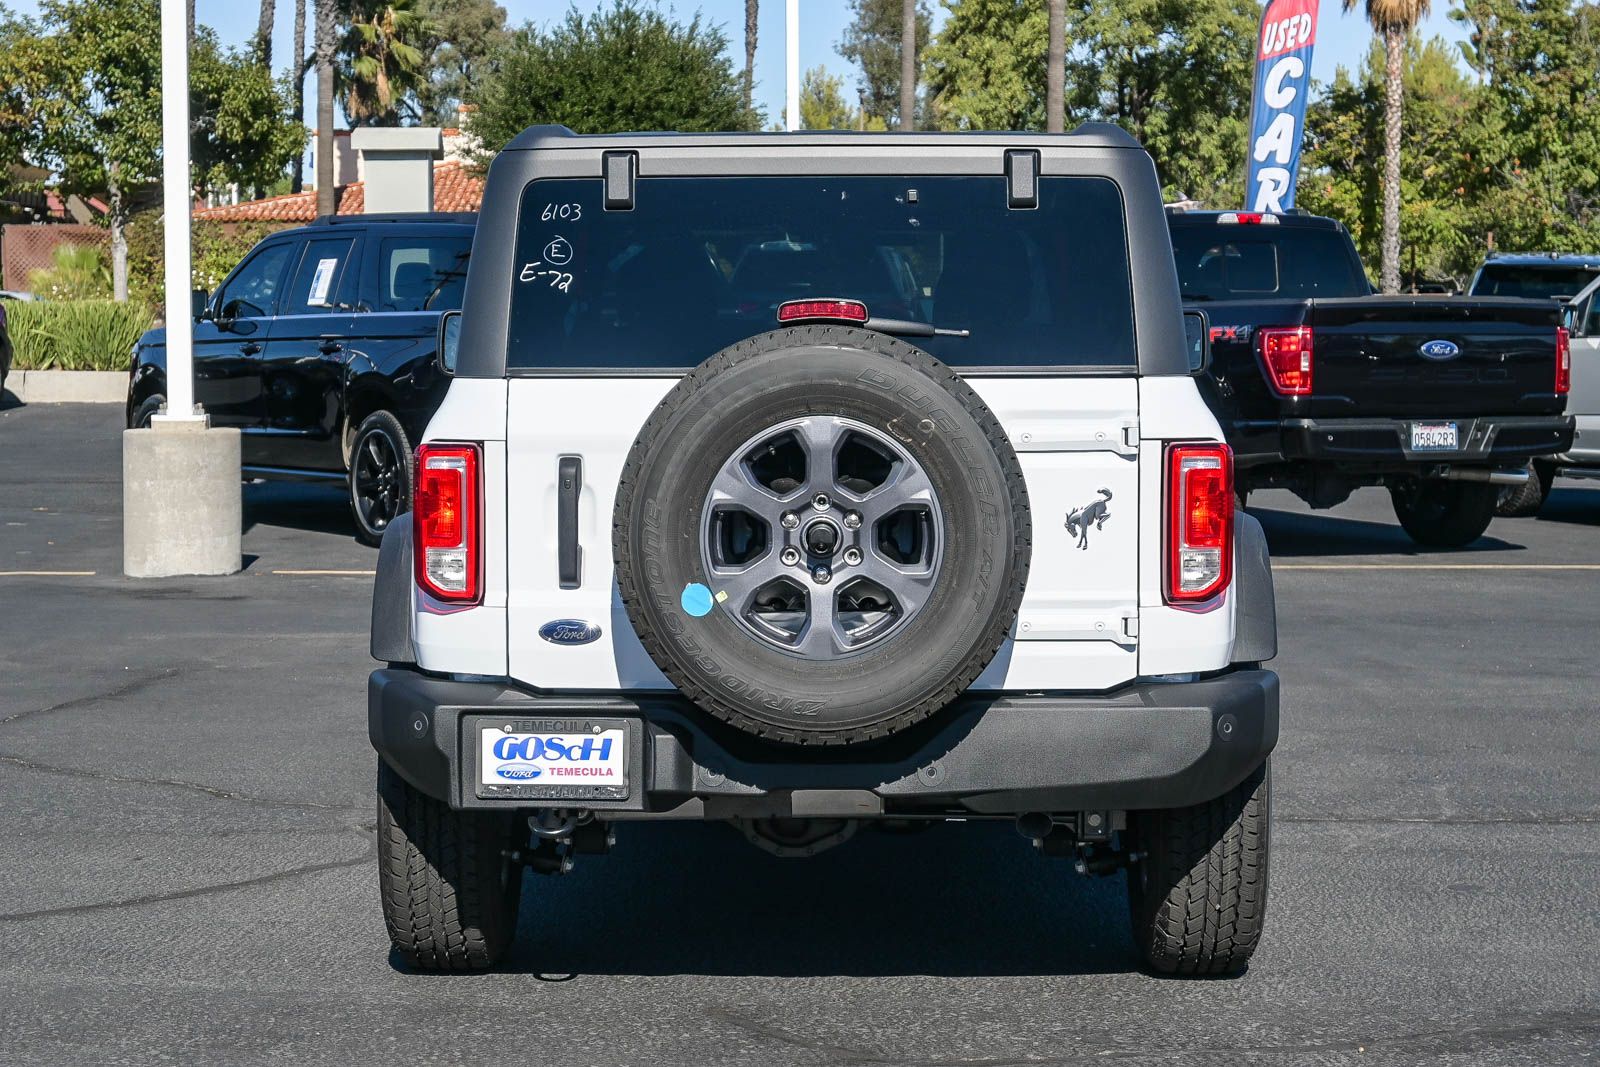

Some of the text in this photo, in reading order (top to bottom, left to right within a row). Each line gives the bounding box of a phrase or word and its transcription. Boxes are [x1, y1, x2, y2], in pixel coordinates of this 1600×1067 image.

[1262, 12, 1312, 55] USED
[541, 203, 582, 221] 6103
[551, 243, 566, 258] E
[519, 261, 573, 294] E-72
[1209, 325, 1252, 343] FX4
[856, 367, 1001, 538] DUELER
[641, 497, 831, 717] BRIDGESTONE
[513, 720, 594, 732] TEMECULA
[549, 767, 614, 777] TEMECULA
